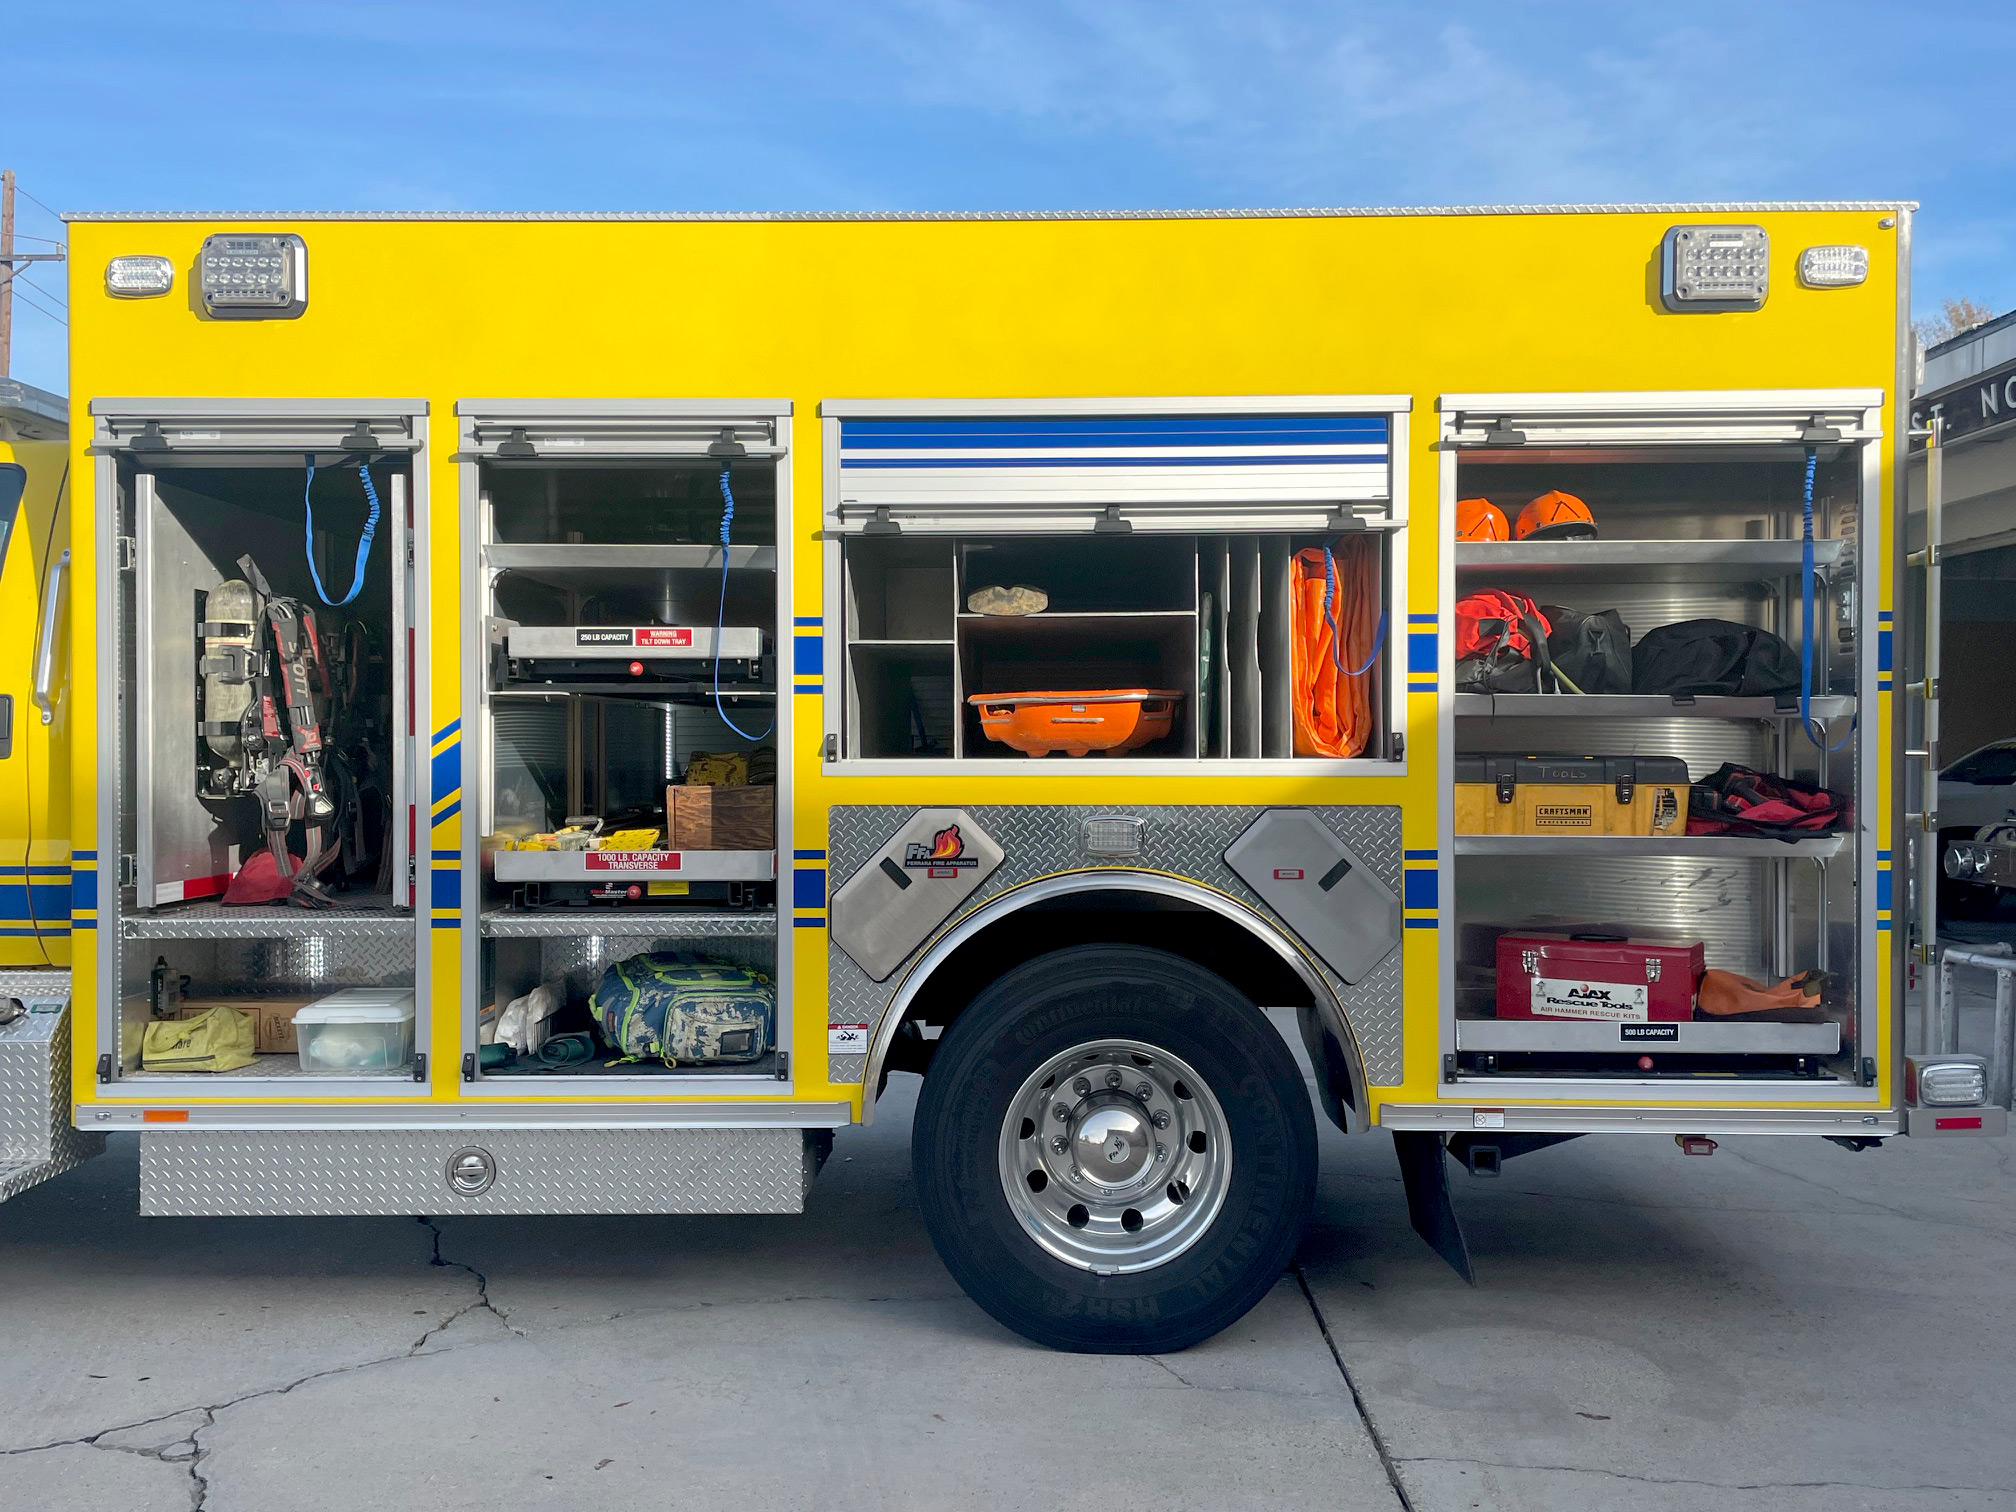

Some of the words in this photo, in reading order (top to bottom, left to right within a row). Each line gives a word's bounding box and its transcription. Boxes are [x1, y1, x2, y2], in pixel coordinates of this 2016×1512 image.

[650, 630, 677, 638] WARNING
[1539, 807, 1589, 816] CRAFTSMAN
[907, 844, 931, 859] FFA
[598, 853, 616, 861] 1000
[618, 853, 630, 861] LB.
[632, 853, 669, 861] CAPACITY
[608, 861, 658, 869] TRANSVERSE
[1546, 996, 1599, 1008] Rescue
[1601, 1000, 1634, 1011] Tools
[1555, 1007, 1588, 1016] HAMMER
[1589, 1009, 1621, 1019] RESCUE
[1623, 1012, 1641, 1020] KITS
[1624, 1028, 1636, 1036] 500
[1637, 1028, 1645, 1036] LB
[1646, 1028, 1675, 1036] CAPACITY
